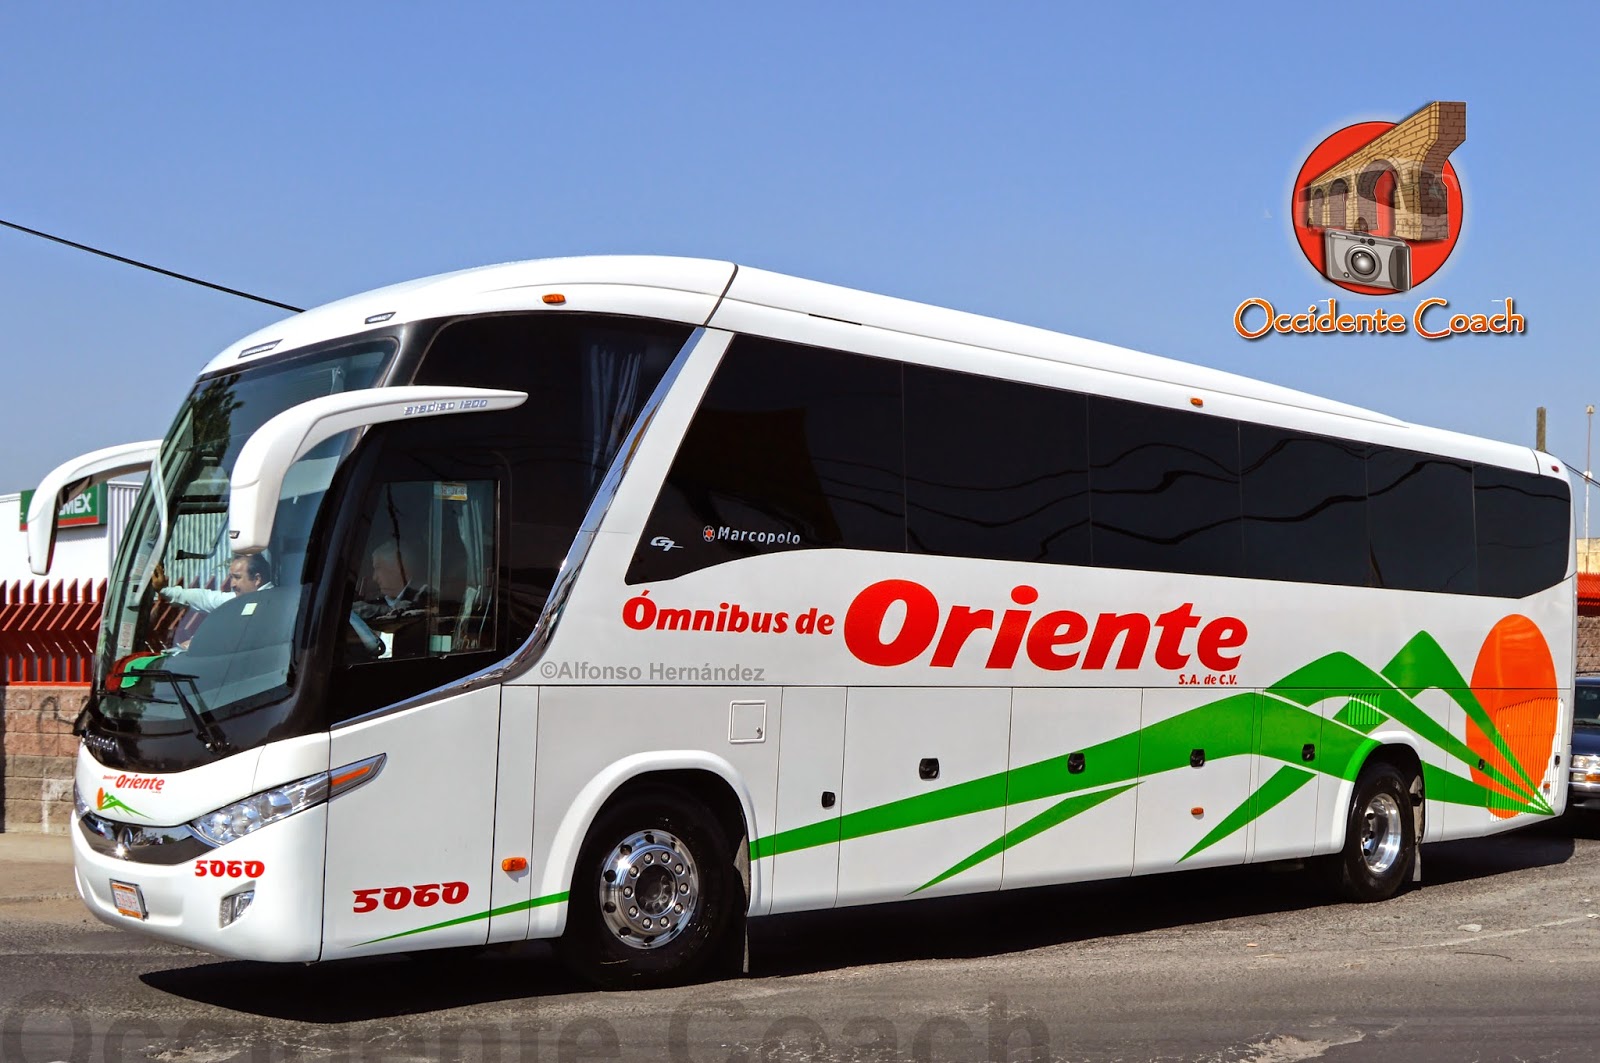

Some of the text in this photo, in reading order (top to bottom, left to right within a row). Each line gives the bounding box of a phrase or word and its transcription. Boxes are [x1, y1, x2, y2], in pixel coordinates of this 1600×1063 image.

[460, 400, 488, 409] 1200
[59, 492, 92, 515] MEX
[717, 526, 801, 545] Marcopolo
[622, 579, 1248, 671] Ómnibus de Oriente
[1204, 674, 1217, 685] de
[1219, 674, 1238, 685] C.V.
[115, 774, 165, 791] Oriente
[194, 860, 265, 878] 5060
[352, 881, 470, 913] 5060
